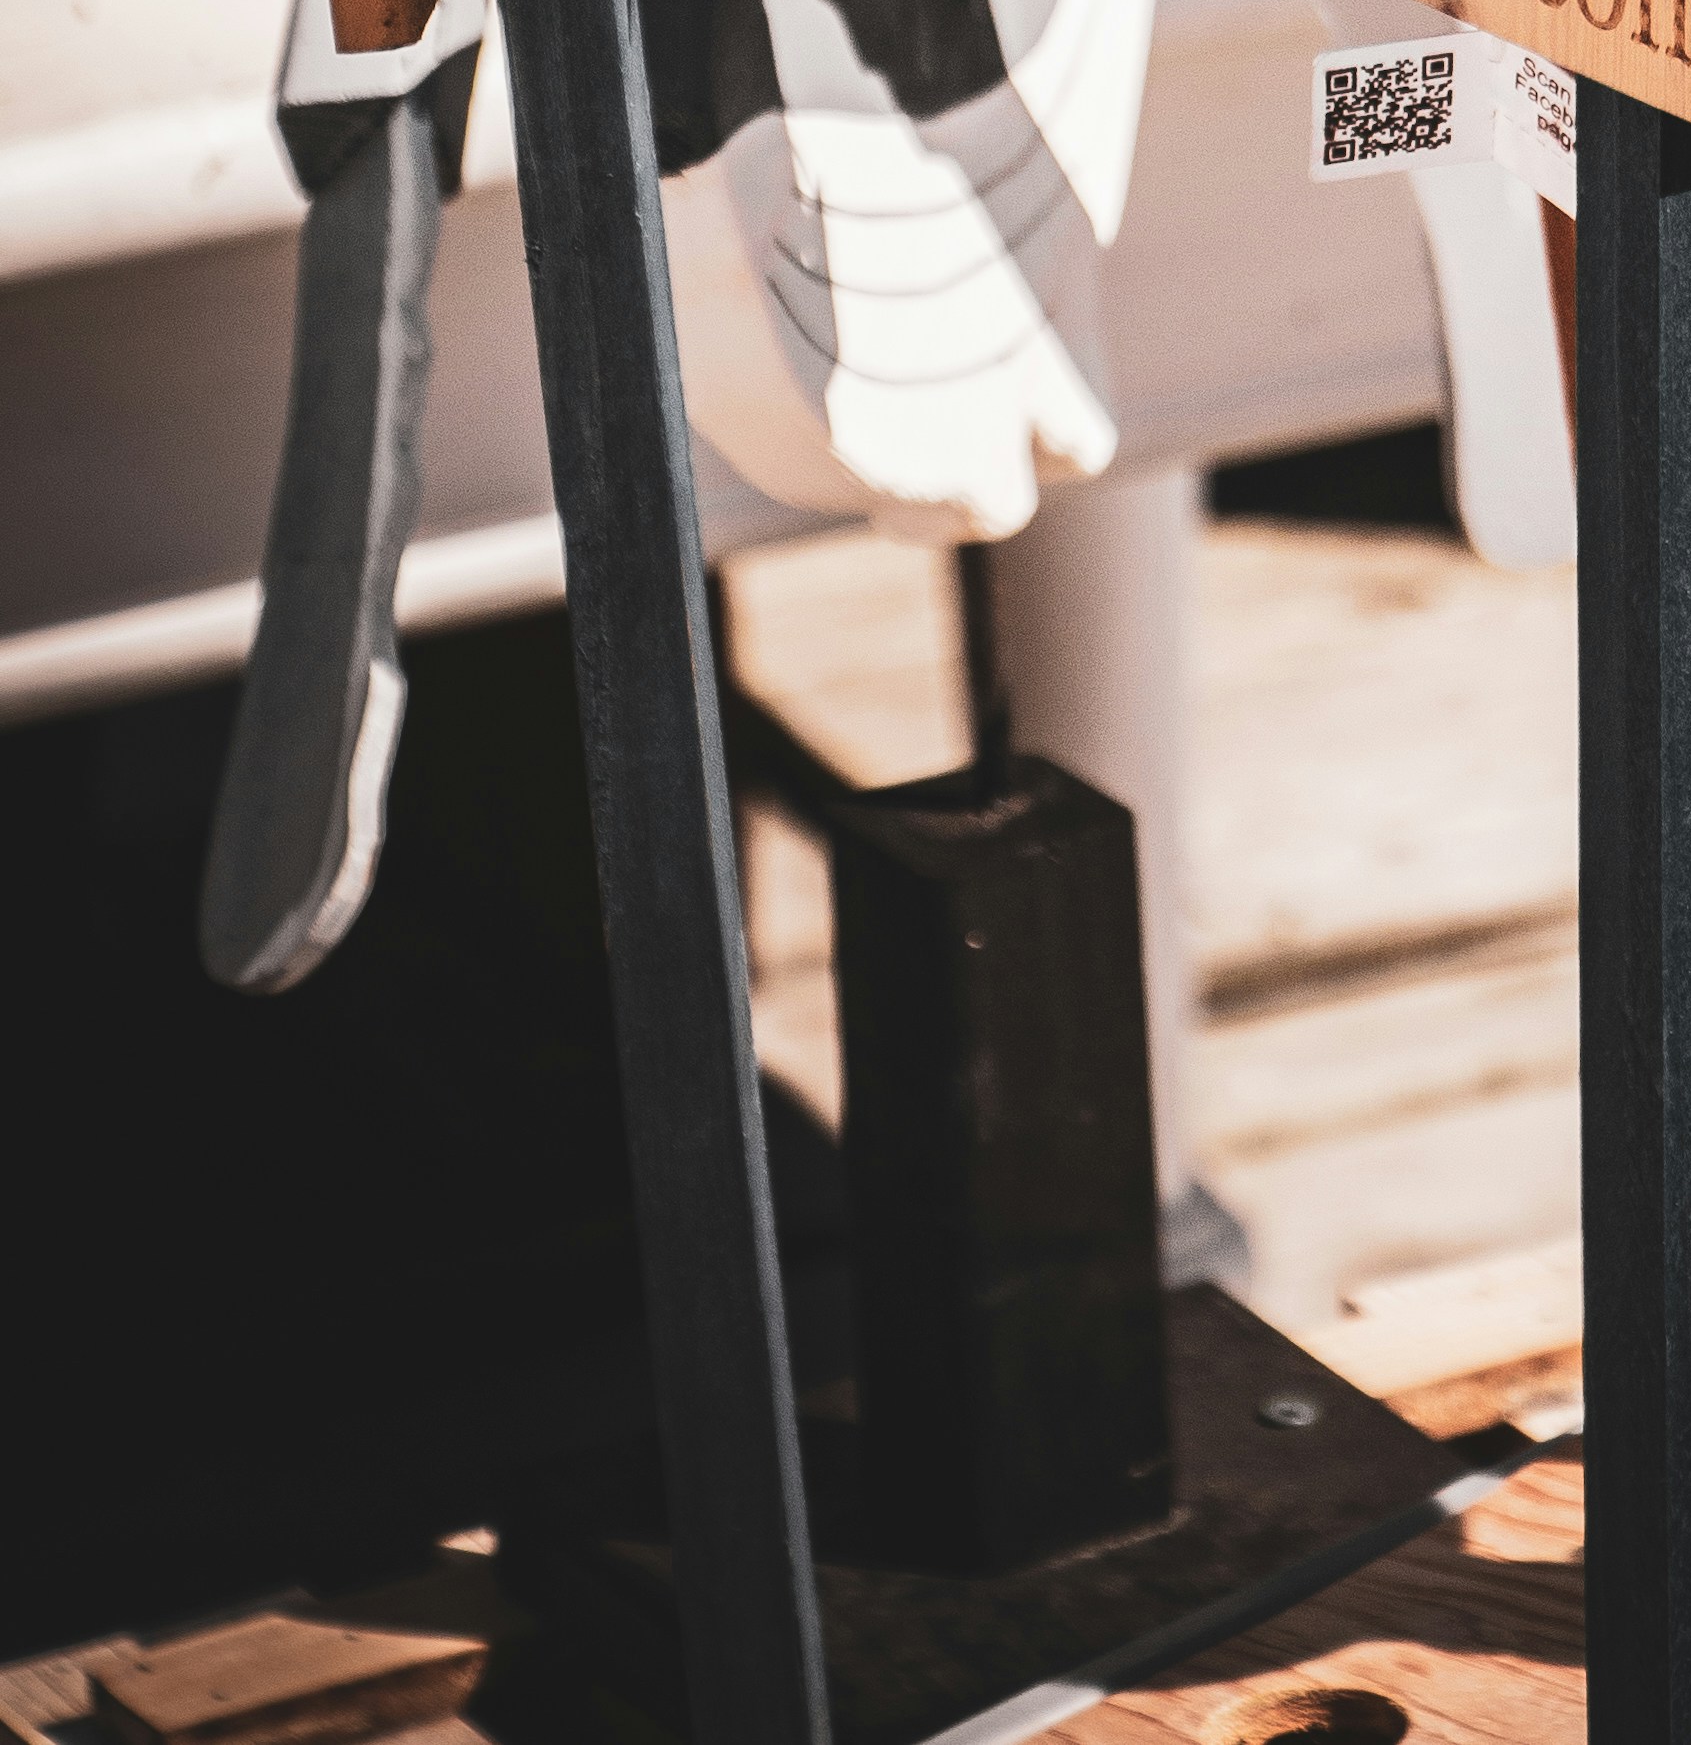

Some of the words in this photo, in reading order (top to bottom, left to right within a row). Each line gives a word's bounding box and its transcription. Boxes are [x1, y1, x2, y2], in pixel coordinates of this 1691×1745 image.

[1515, 72, 1574, 128] Faceb
[1522, 56, 1571, 106] Scan
[1536, 114, 1573, 153] pag
